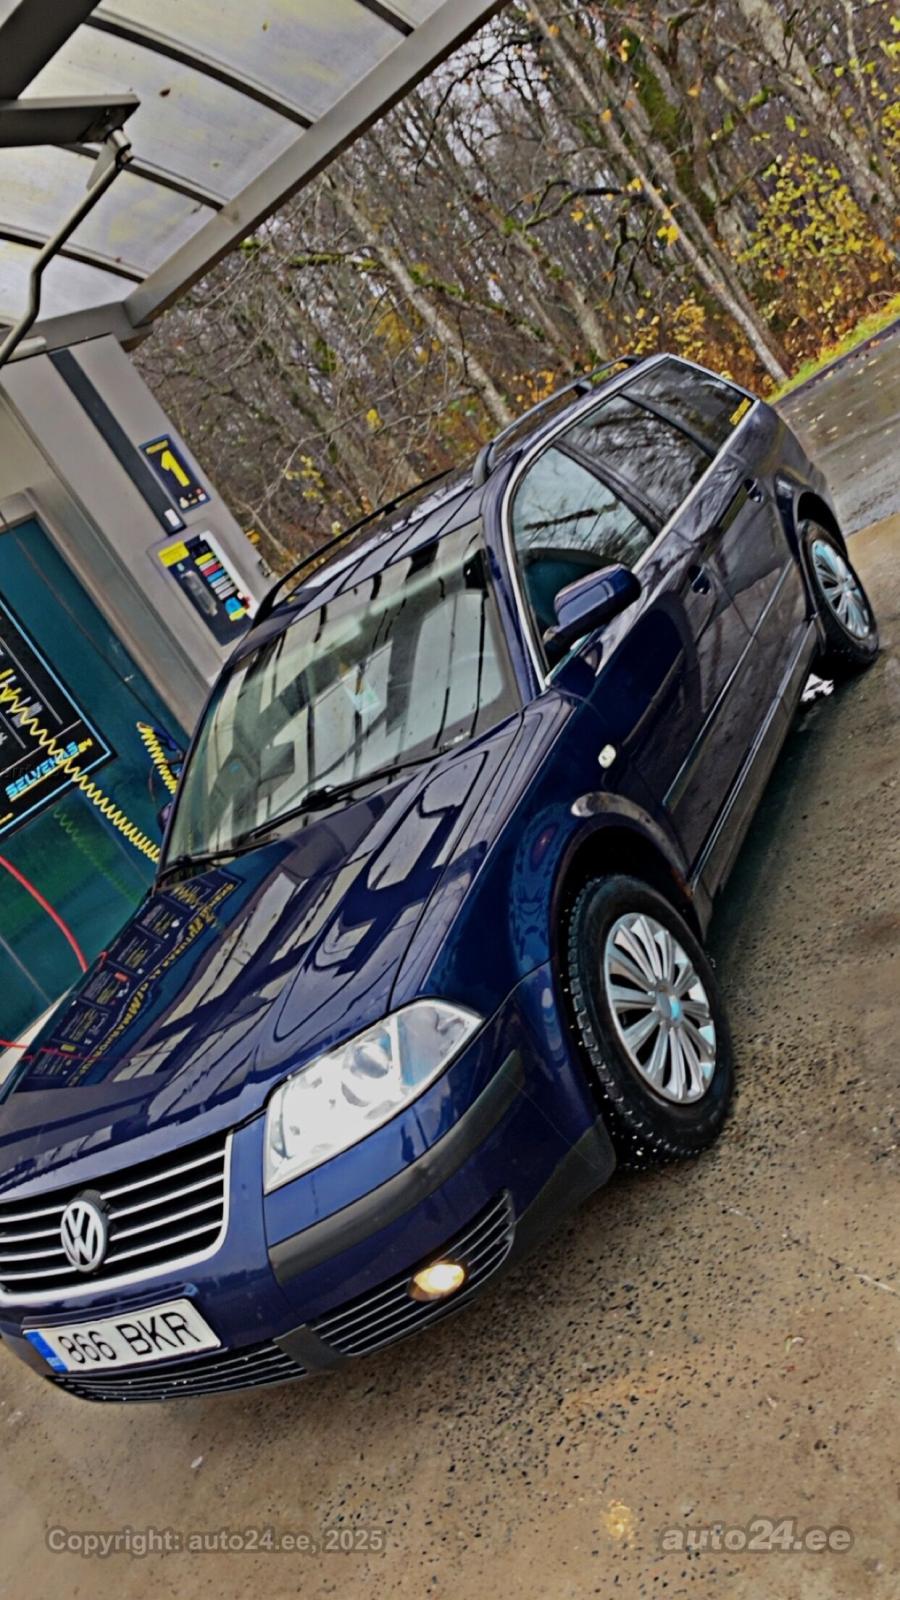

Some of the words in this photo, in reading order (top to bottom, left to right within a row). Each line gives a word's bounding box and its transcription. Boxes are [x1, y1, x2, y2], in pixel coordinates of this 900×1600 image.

[160, 450, 191, 487] 1
[61, 1200, 105, 1273] VW
[58, 1331, 117, 1363] 866
[115, 1312, 200, 1356] BKR
